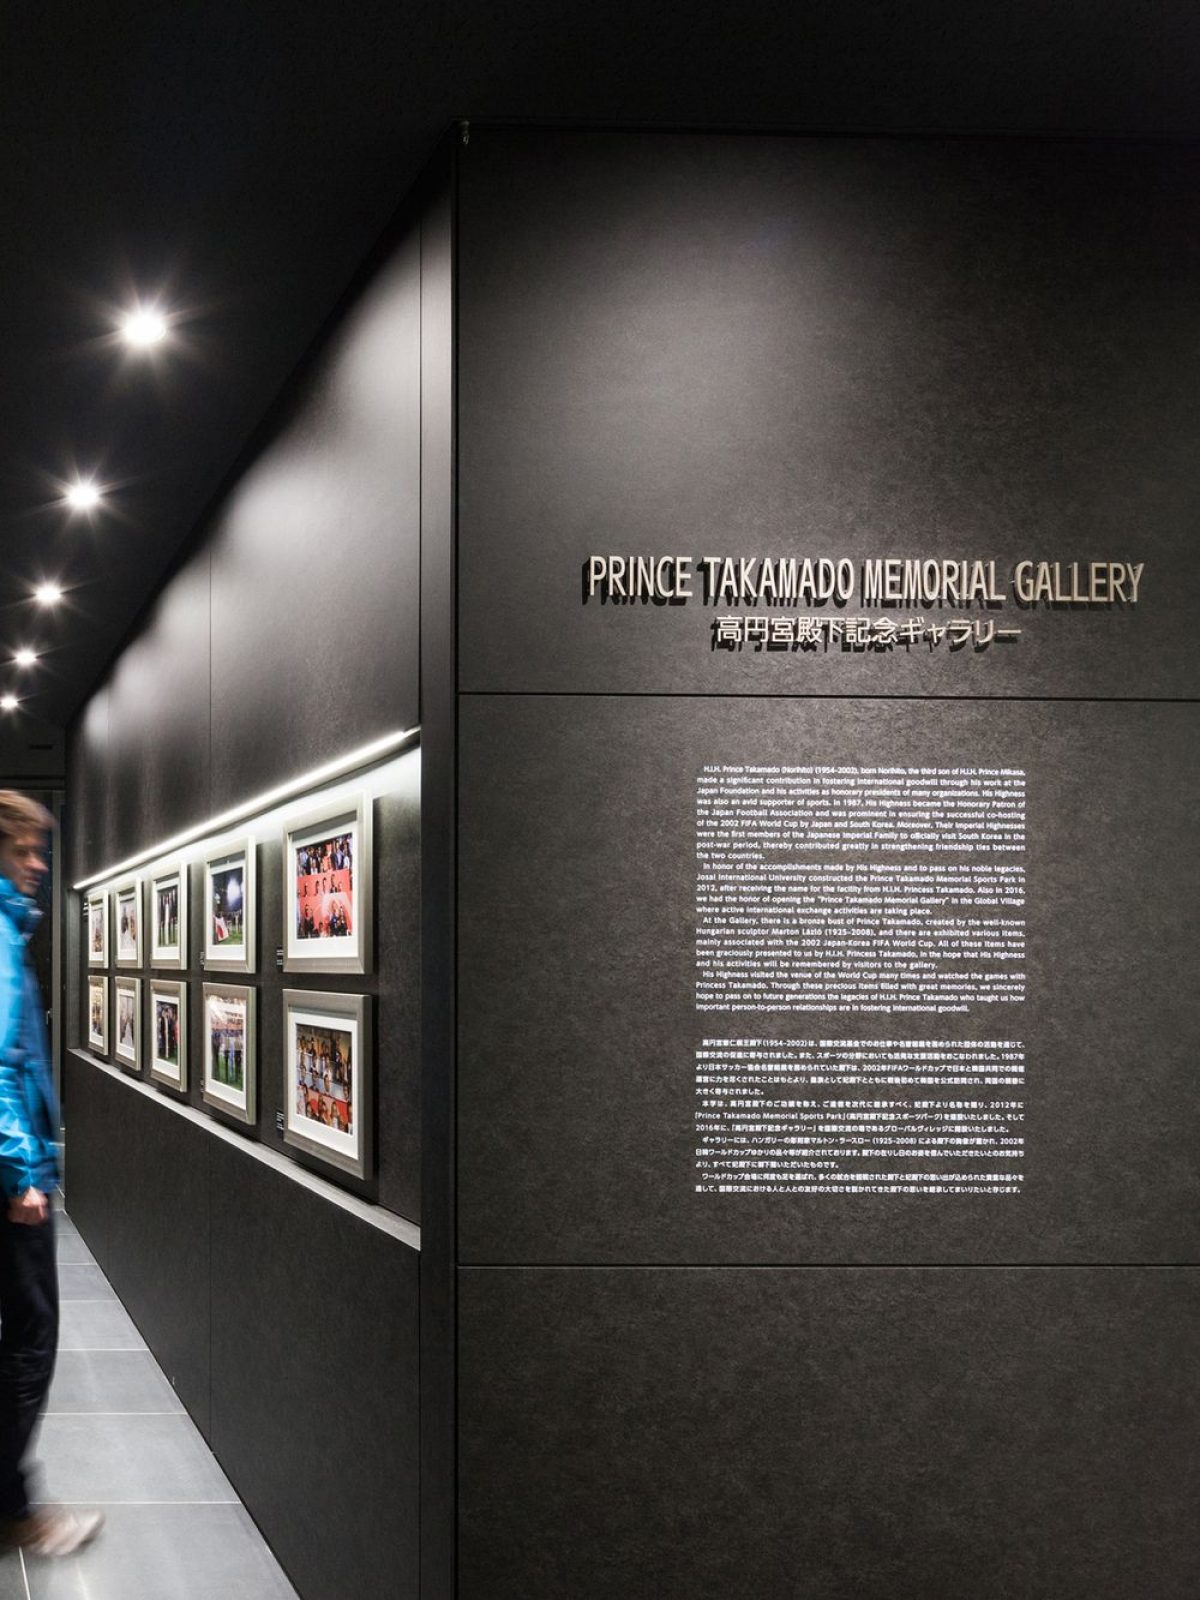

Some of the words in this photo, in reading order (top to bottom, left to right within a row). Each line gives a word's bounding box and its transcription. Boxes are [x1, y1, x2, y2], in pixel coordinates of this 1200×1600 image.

[588, 556, 693, 597] PRINCE
[702, 557, 855, 600] TAKAMADO
[864, 559, 1007, 602] MEMORIAL
[1014, 560, 1145, 603] GALLERY
[717, 615, 1023, 645] 高円宮殿下記念ギャラリー
[696, 807, 709, 816] the
[712, 808, 734, 818] Japan
[736, 808, 767, 816] Football
[770, 808, 813, 817] Association
[815, 809, 829, 817] and
[848, 809, 887, 819] prominent
[898, 809, 930, 820] ensuring
[932, 810, 944, 818] the
[946, 810, 984, 818] successful
[706, 818, 718, 827] the
[720, 818, 739, 827] 2002
[740, 819, 757, 827] FIFA
[759, 819, 781, 827] World
[783, 819, 798, 829] Cup
[811, 819, 832, 830] Japan
[834, 819, 848, 828] and
[849, 820, 870, 828] South
[935, 820, 953, 829] Their
[955, 821, 984, 831] Imperial
[986, 821, 1025, 831] Highnesses
[762, 840, 792, 851] thereby
[794, 841, 839, 849] contributed
[842, 841, 868, 851] greatly
[881, 841, 933, 852] strengthening
[935, 842, 973, 852] friendship
[976, 842, 990, 851] ties
[992, 842, 1025, 851] between
[696, 851, 709, 859] the
[710, 851, 725, 859] two
[697, 872, 716, 881] Josai
[718, 872, 766, 881] International
[768, 873, 806, 883] University
[808, 873, 853, 882] constructed
[855, 873, 868, 882] the
[870, 874, 893, 882] Prince
[896, 874, 934, 882] Takamado
[936, 874, 971, 883] Memorial
[973, 875, 997, 885] Sports
[999, 875, 1015, 883] Park
[719, 883, 736, 892] after
[738, 883, 772, 894] receiving
[773, 884, 786, 892] the
[810, 884, 820, 892] for
[822, 884, 835, 892] the
[836, 884, 861, 894] facility
[863, 884, 880, 893] from
[904, 885, 933, 893] Princess
[977, 885, 993, 894] Also
[708, 894, 723, 902] had
[724, 894, 737, 902] the
[738, 894, 760, 902] honor
[772, 894, 801, 905] opening
[802, 895, 815, 903] the
[845, 895, 882, 904] Takamado
[884, 895, 918, 904] Memorial
[960, 896, 972, 904] the
[974, 896, 998, 905] Global
[1000, 896, 1025, 907] Village
[696, 904, 719, 913] where
[721, 905, 744, 913] active
[746, 905, 794, 914] international
[796, 905, 831, 916] exchange
[834, 906, 867, 914] activities
[884, 906, 907, 916] taking
[714, 915, 726, 924] the
[760, 916, 781, 924] there
[798, 916, 825, 925] bronze
[827, 916, 844, 925] bust
[856, 917, 880, 925] Prince
[925, 917, 954, 926] created
[968, 917, 980, 926] the
[696, 937, 720, 947] mainly
[723, 937, 764, 946] associated
[767, 937, 783, 946] with
[785, 937, 798, 946] the
[801, 938, 820, 946] 2002
[872, 938, 890, 947] FIFA
[892, 938, 916, 947] World
[938, 939, 948, 947] All
[960, 939, 982, 947] these
[984, 939, 1005, 947] items
[1007, 939, 1025, 948] have
[696, 958, 710, 967] and
[712, 958, 724, 967] his
[726, 959, 761, 967] activities
[763, 959, 777, 967] will
[791, 959, 840, 968] remembered
[854, 959, 881, 968] visitors
[894, 960, 907, 968] the
